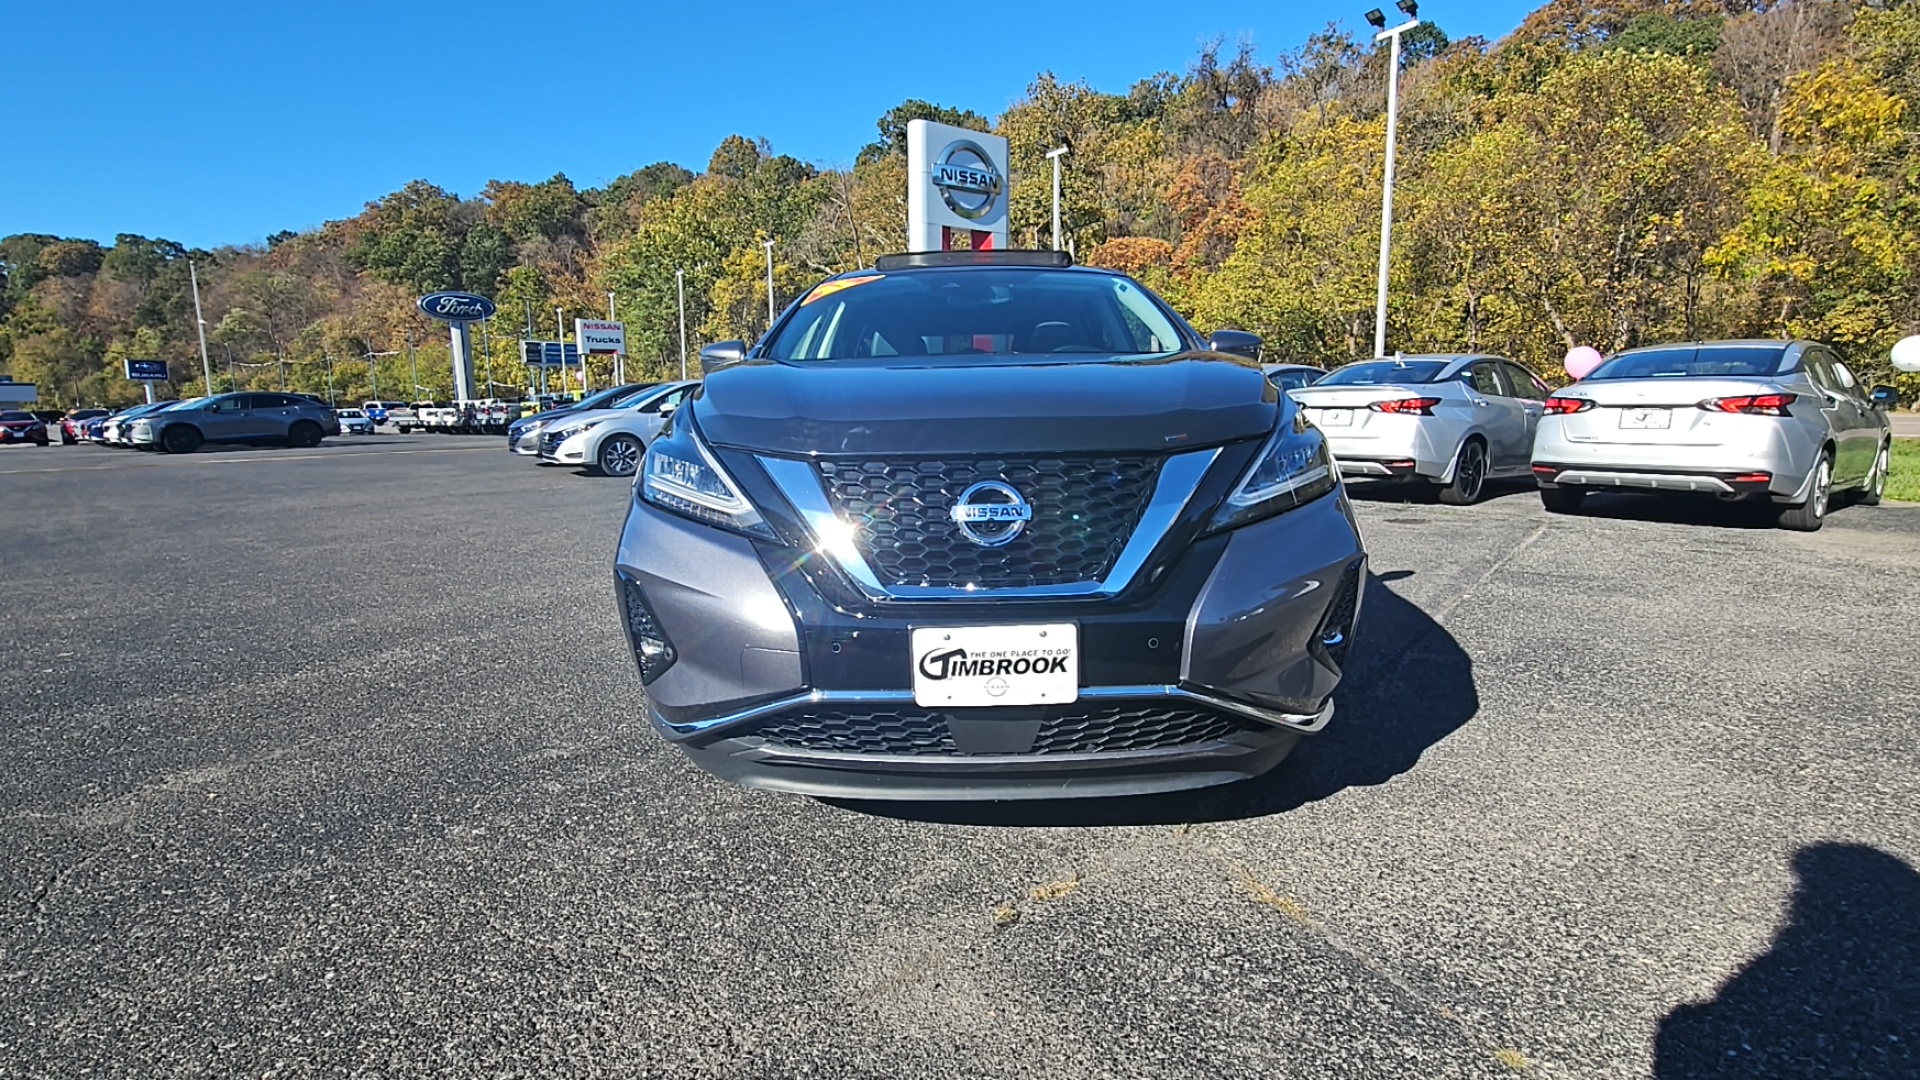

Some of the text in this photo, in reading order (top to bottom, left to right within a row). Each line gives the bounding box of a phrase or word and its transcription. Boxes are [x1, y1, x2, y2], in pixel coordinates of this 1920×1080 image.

[940, 168, 998, 189] NISSAN
[436, 296, 482, 315] Ford
[583, 322, 621, 331] NISSAN
[585, 335, 621, 344] Trucks
[960, 507, 1023, 518] NISSAN
[919, 648, 1069, 680] TIMBROOK
